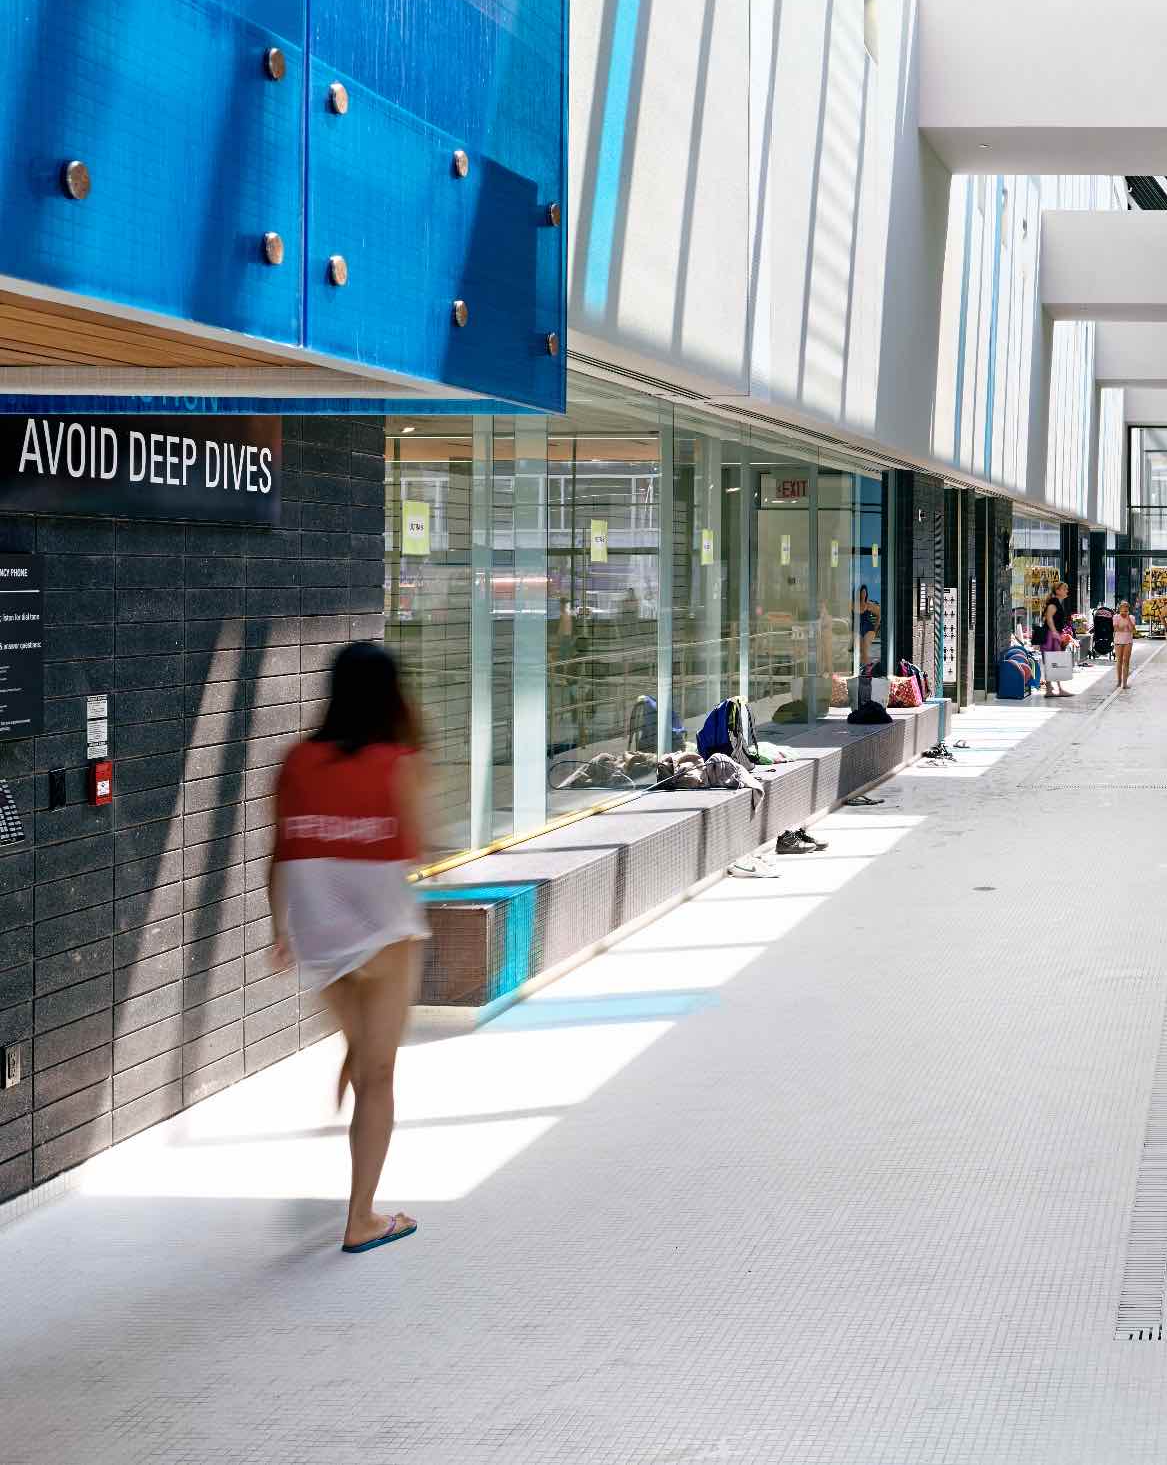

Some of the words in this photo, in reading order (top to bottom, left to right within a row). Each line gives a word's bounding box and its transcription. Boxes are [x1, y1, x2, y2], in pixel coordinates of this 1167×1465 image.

[19, 418, 118, 479] AVOID
[129, 430, 197, 486] DEEP
[205, 441, 272, 494] DIVES
[783, 480, 807, 497] EXIT
